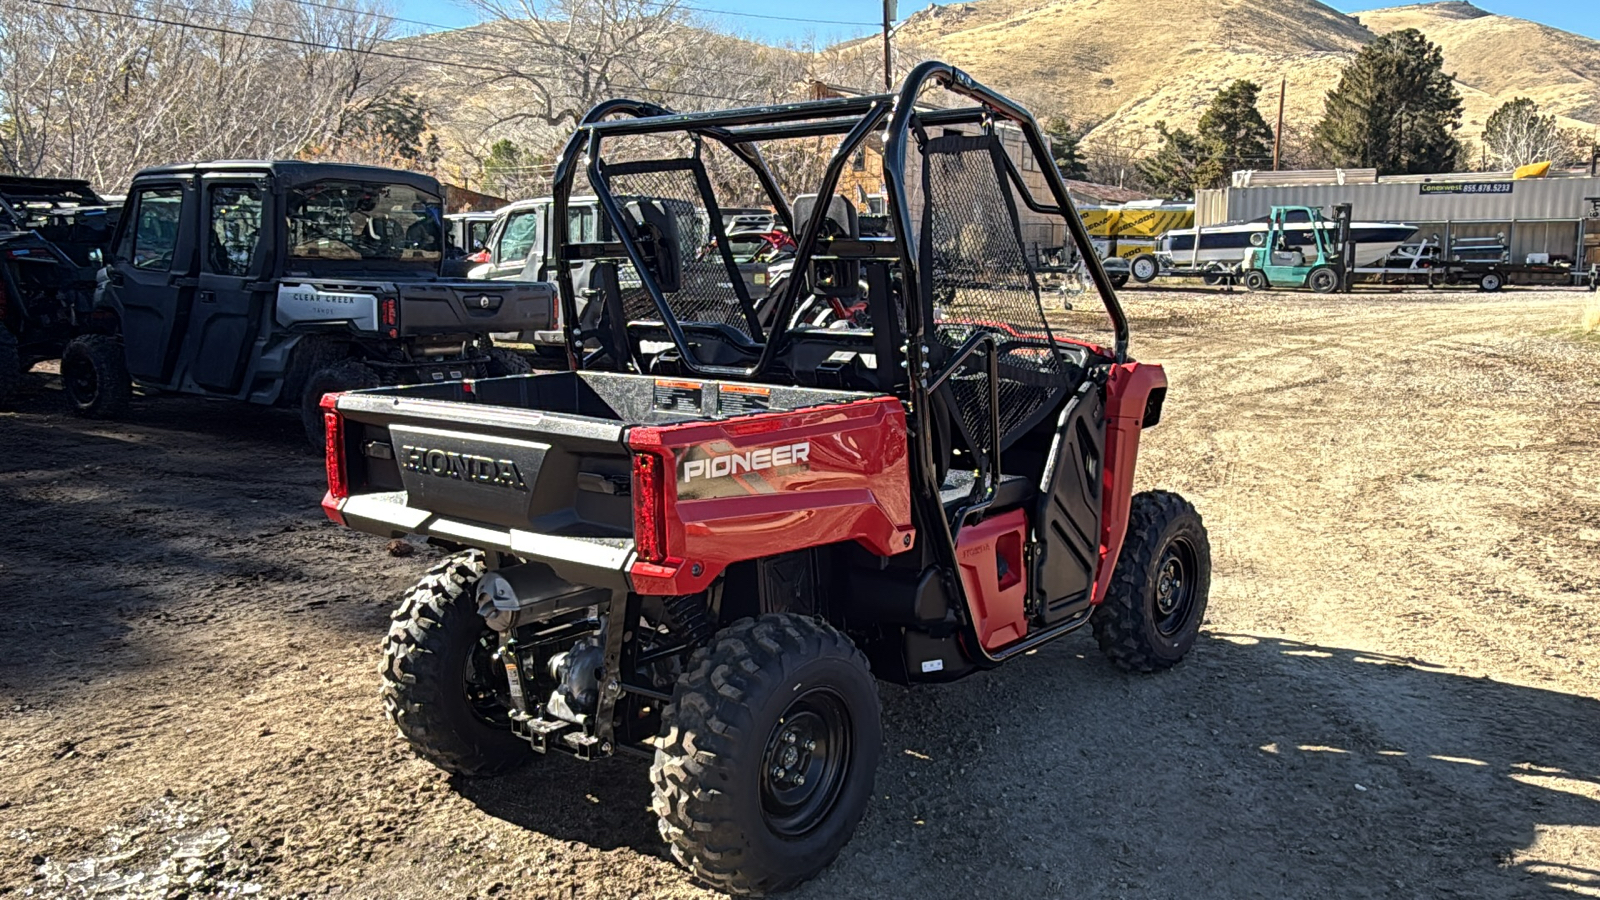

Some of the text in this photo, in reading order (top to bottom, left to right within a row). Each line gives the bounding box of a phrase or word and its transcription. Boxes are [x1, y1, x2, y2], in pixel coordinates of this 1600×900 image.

[293, 293, 355, 304] CLEAR CREEK
[402, 445, 528, 489] HONDA
[684, 441, 810, 483] PIONEER
